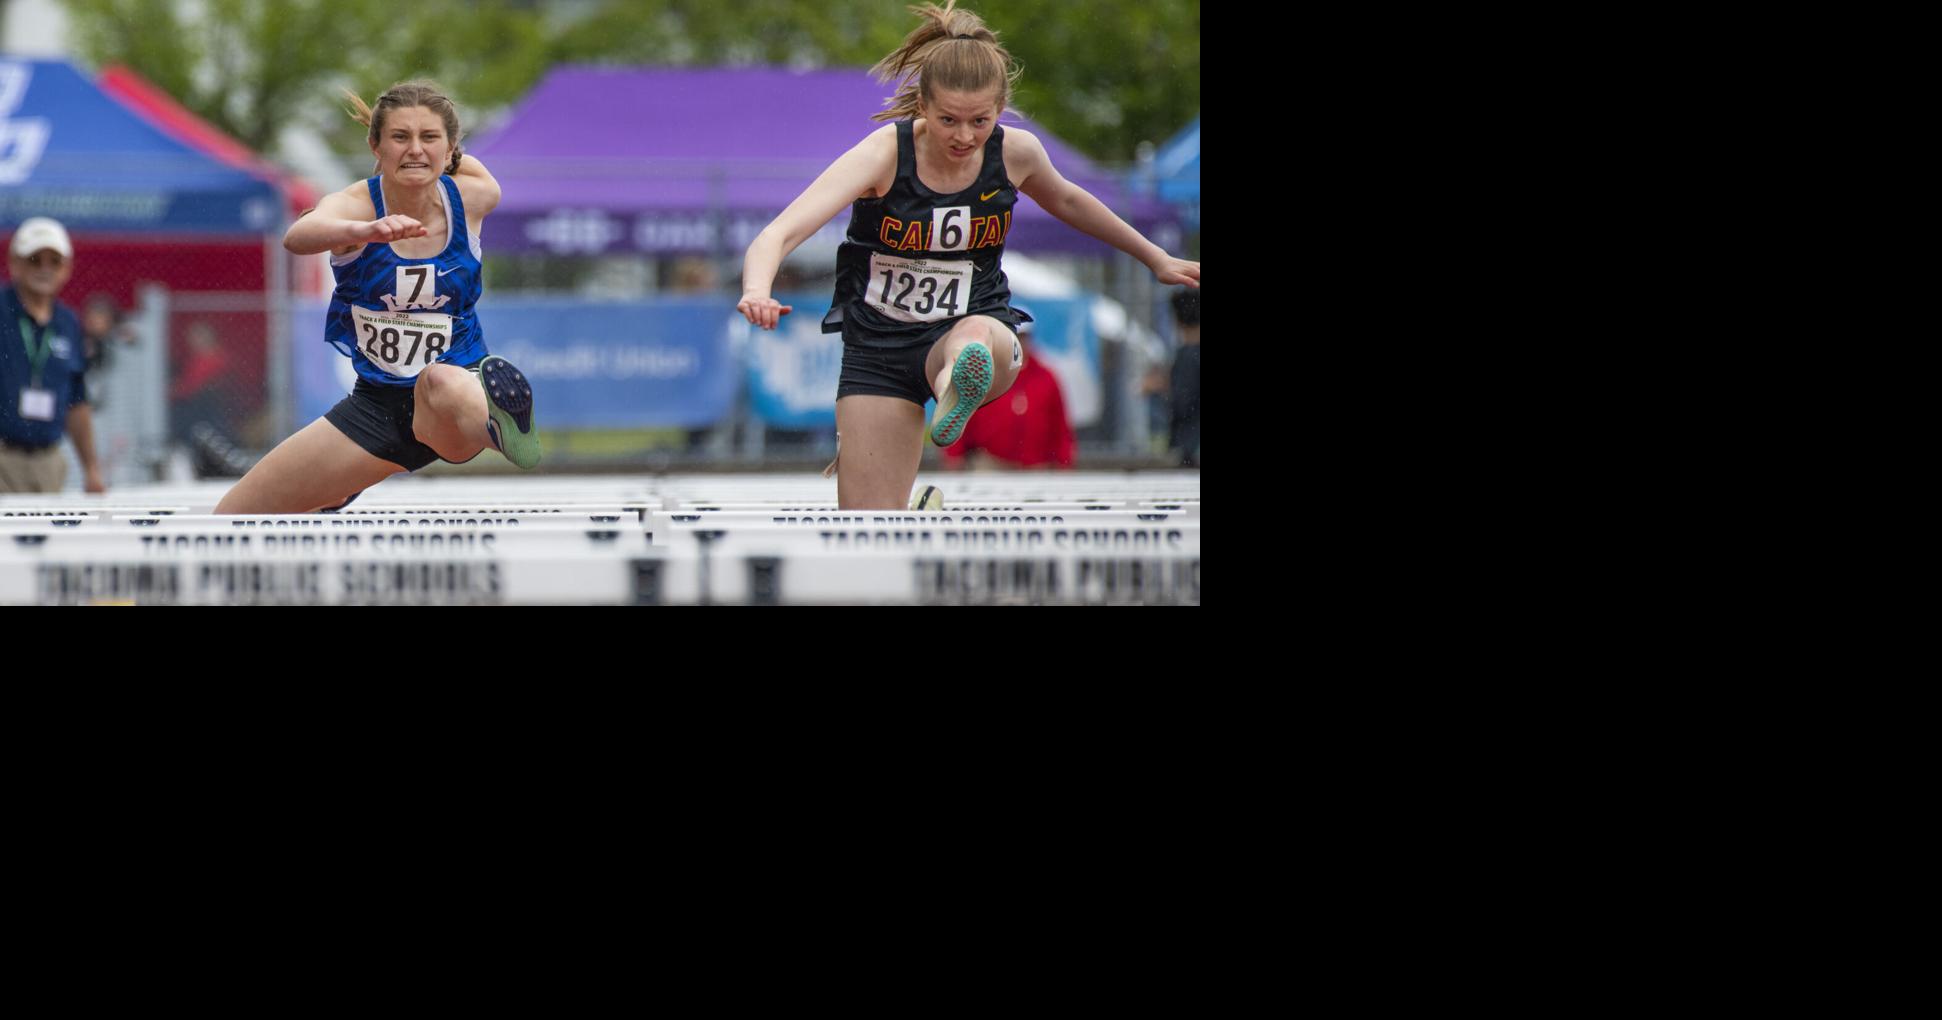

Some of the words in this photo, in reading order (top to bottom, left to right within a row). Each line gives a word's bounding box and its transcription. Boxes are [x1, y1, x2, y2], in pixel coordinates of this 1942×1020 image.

[880, 211, 1011, 250] CATA
[939, 208, 963, 250] 6
[404, 267, 428, 304] 7
[880, 269, 960, 317] 1234
[363, 323, 446, 366] 2878
[392, 319, 406, 327] STATE
[406, 321, 448, 330] CHAMPIONSHIPS
